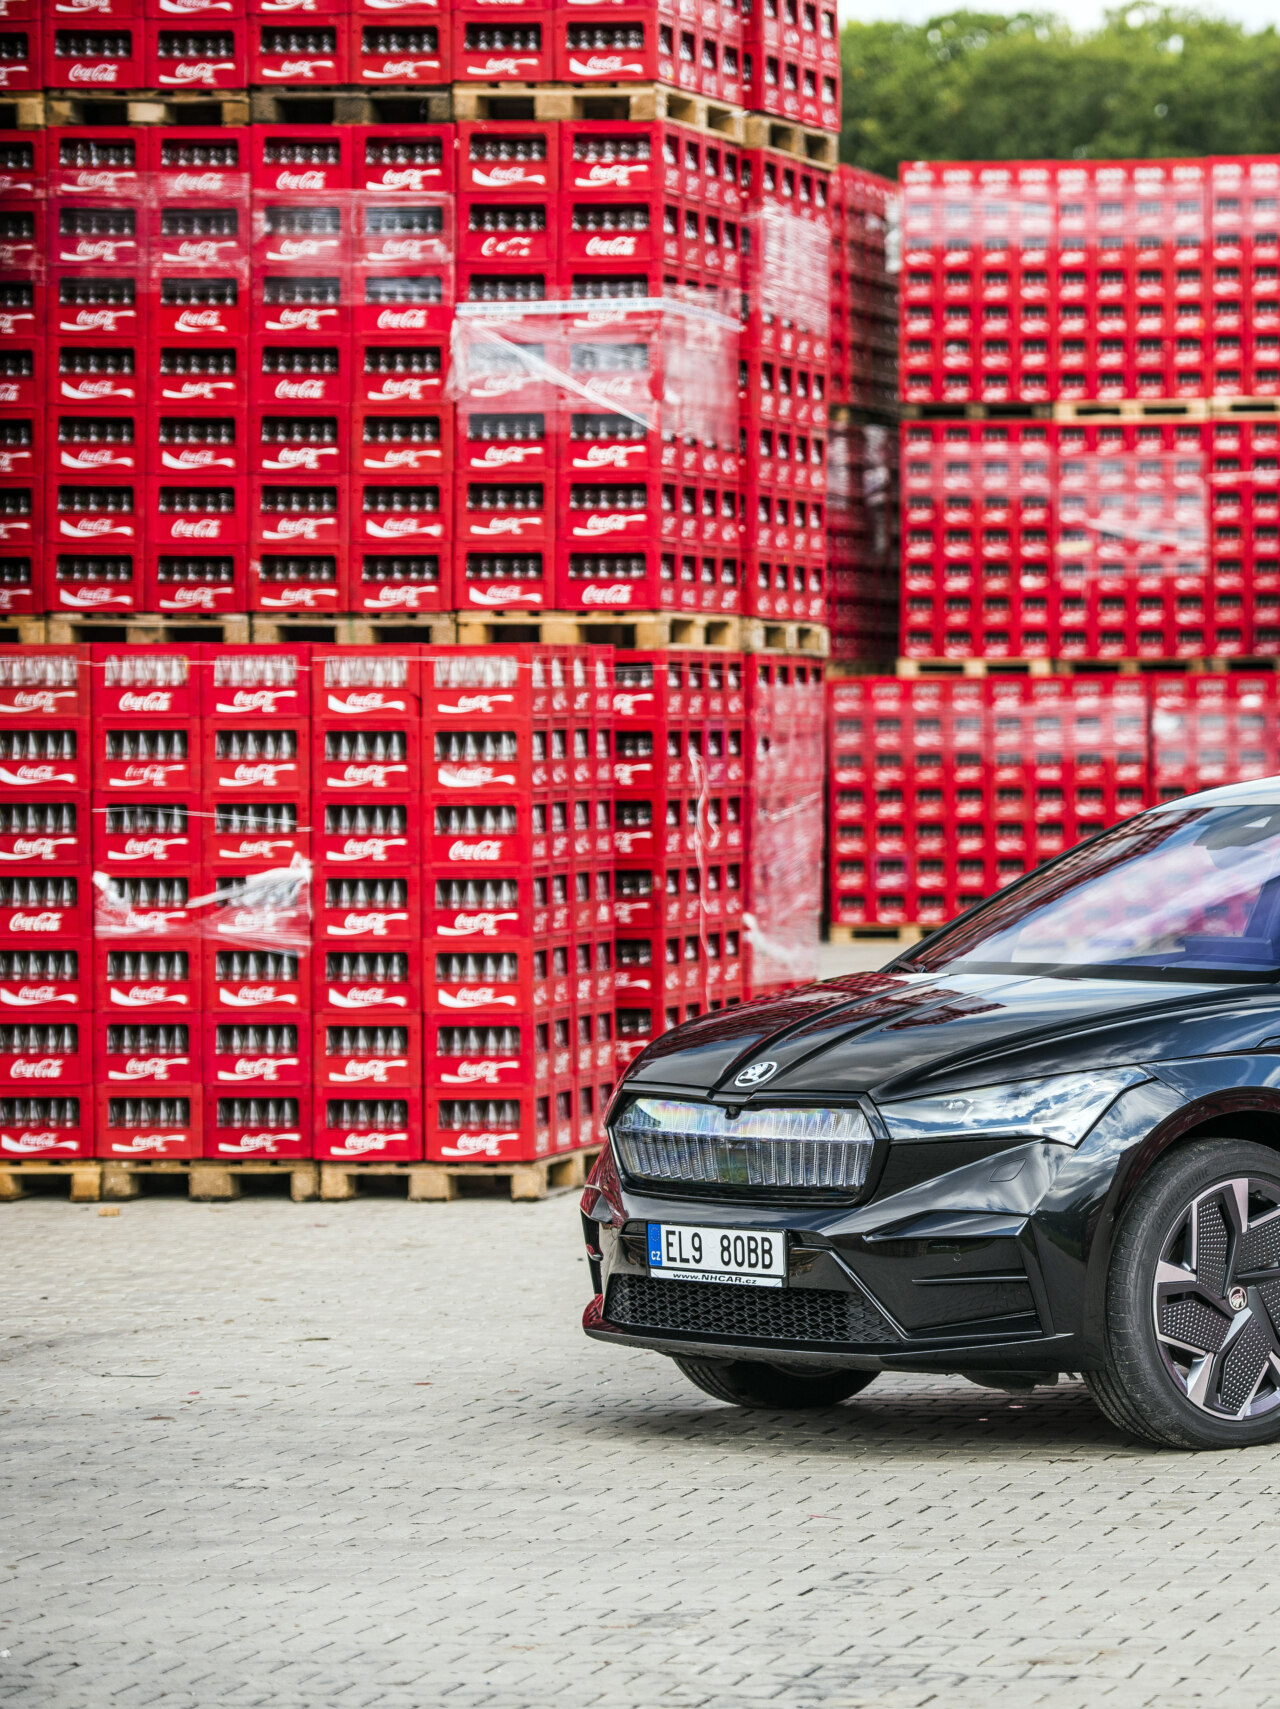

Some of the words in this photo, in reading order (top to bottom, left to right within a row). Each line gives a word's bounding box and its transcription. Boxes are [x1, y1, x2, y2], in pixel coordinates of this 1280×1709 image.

[651, 1251, 661, 1261] CZ
[665, 1230, 703, 1264] EL9
[720, 1234, 773, 1269] 80BB
[672, 1272, 757, 1285] www.NHCAR.cz
